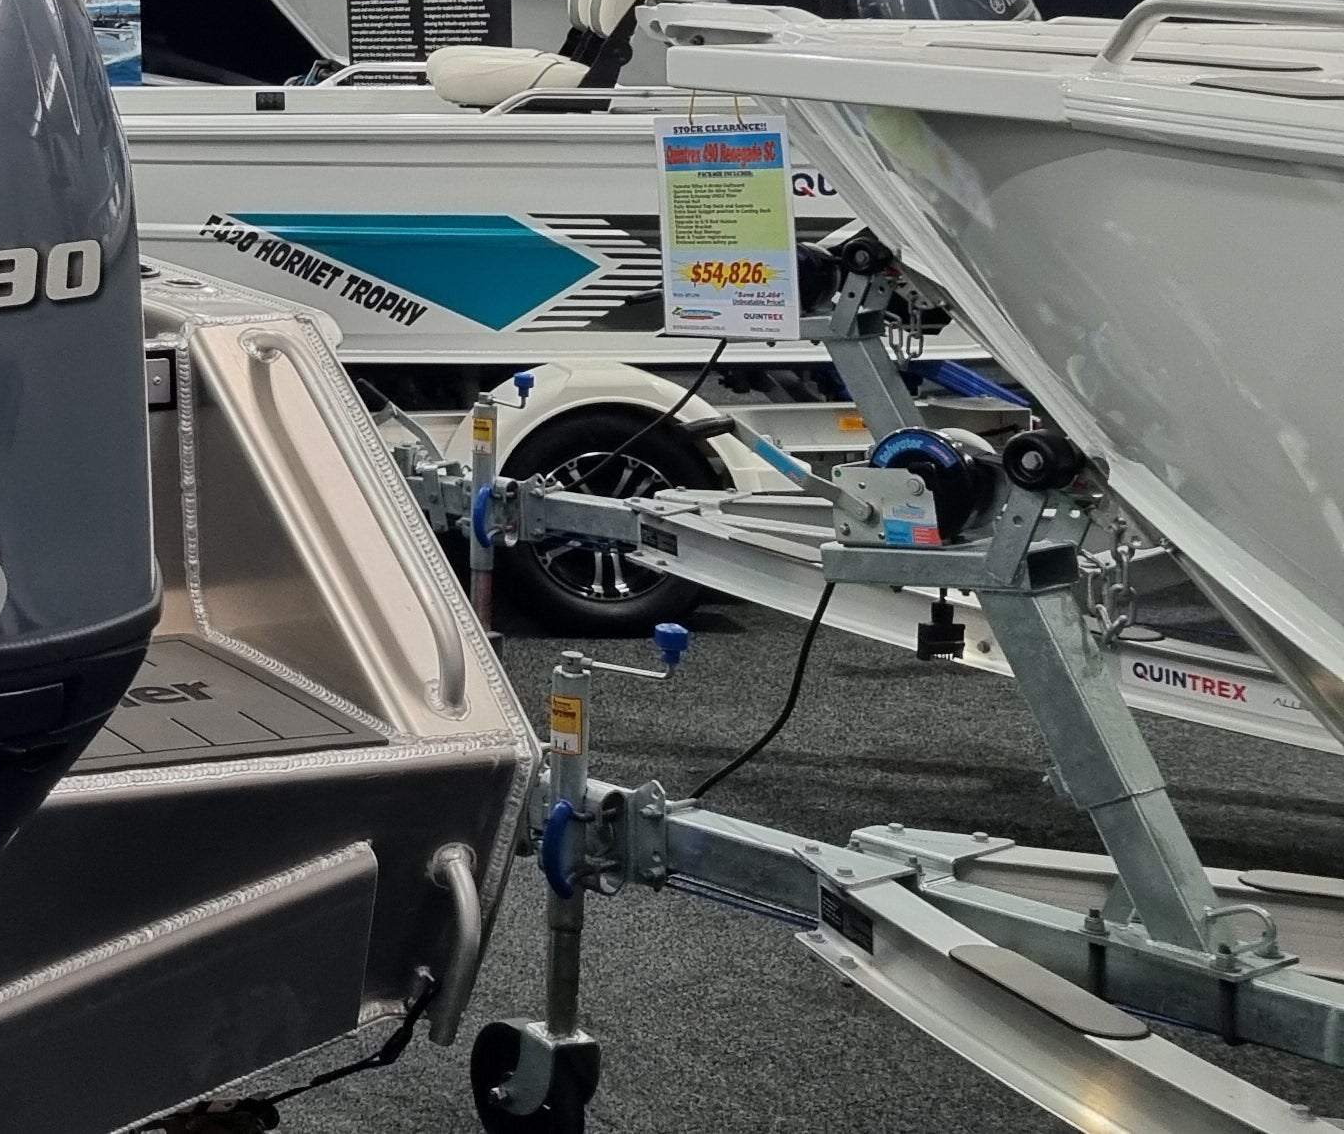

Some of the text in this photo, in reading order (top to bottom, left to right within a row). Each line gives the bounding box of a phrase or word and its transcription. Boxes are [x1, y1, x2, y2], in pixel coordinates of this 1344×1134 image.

[673, 125, 702, 134] STOCK
[254, 238, 345, 290] HORNET
[339, 273, 428, 327] TROPHY
[691, 261, 767, 288] $54,826.
[1132, 662, 1247, 702] QUINTREX
